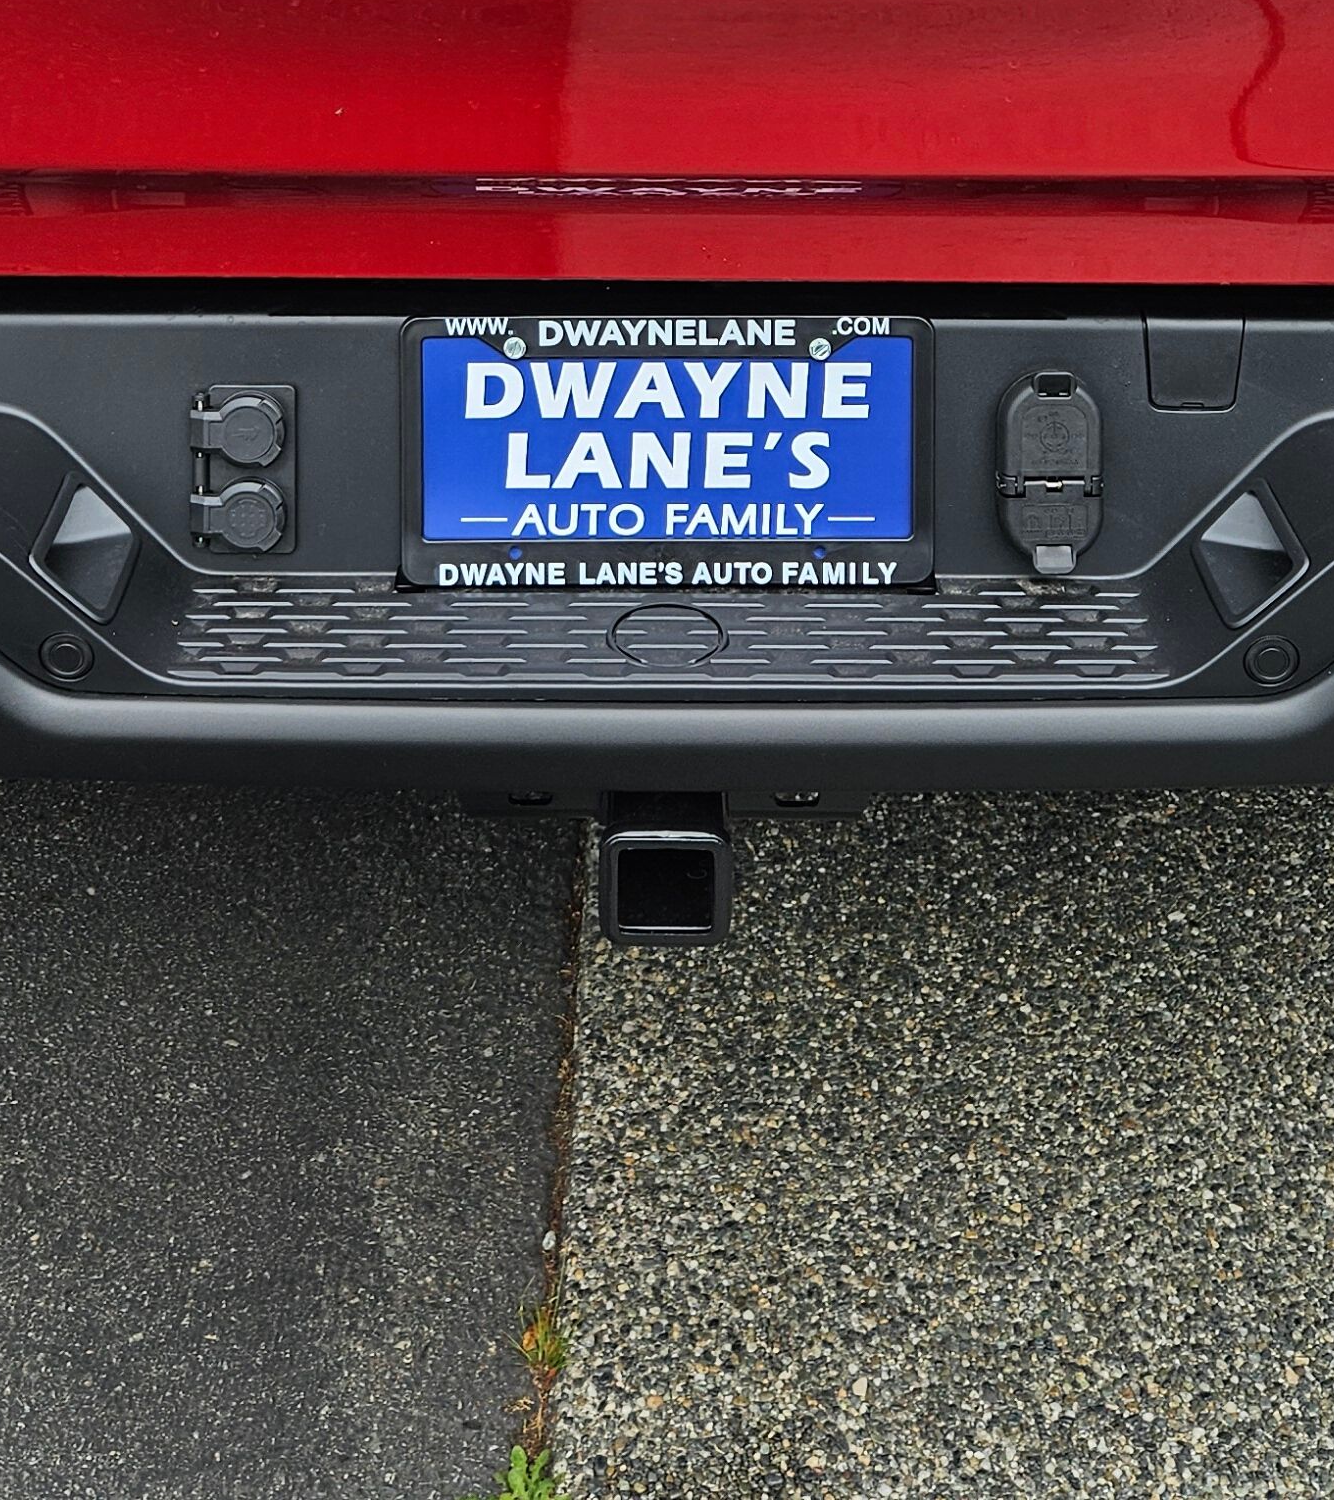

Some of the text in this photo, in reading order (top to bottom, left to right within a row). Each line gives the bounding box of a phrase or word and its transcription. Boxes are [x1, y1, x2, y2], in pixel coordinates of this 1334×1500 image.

[445, 316, 891, 347] WWW. DWAYNELANE .COM
[464, 361, 873, 420] DWAYNE
[504, 431, 831, 490] LANE'S
[511, 503, 825, 536] AUTO FAMILY
[438, 561, 898, 586] DWAYNE LANE'S AUTO FAMILY
